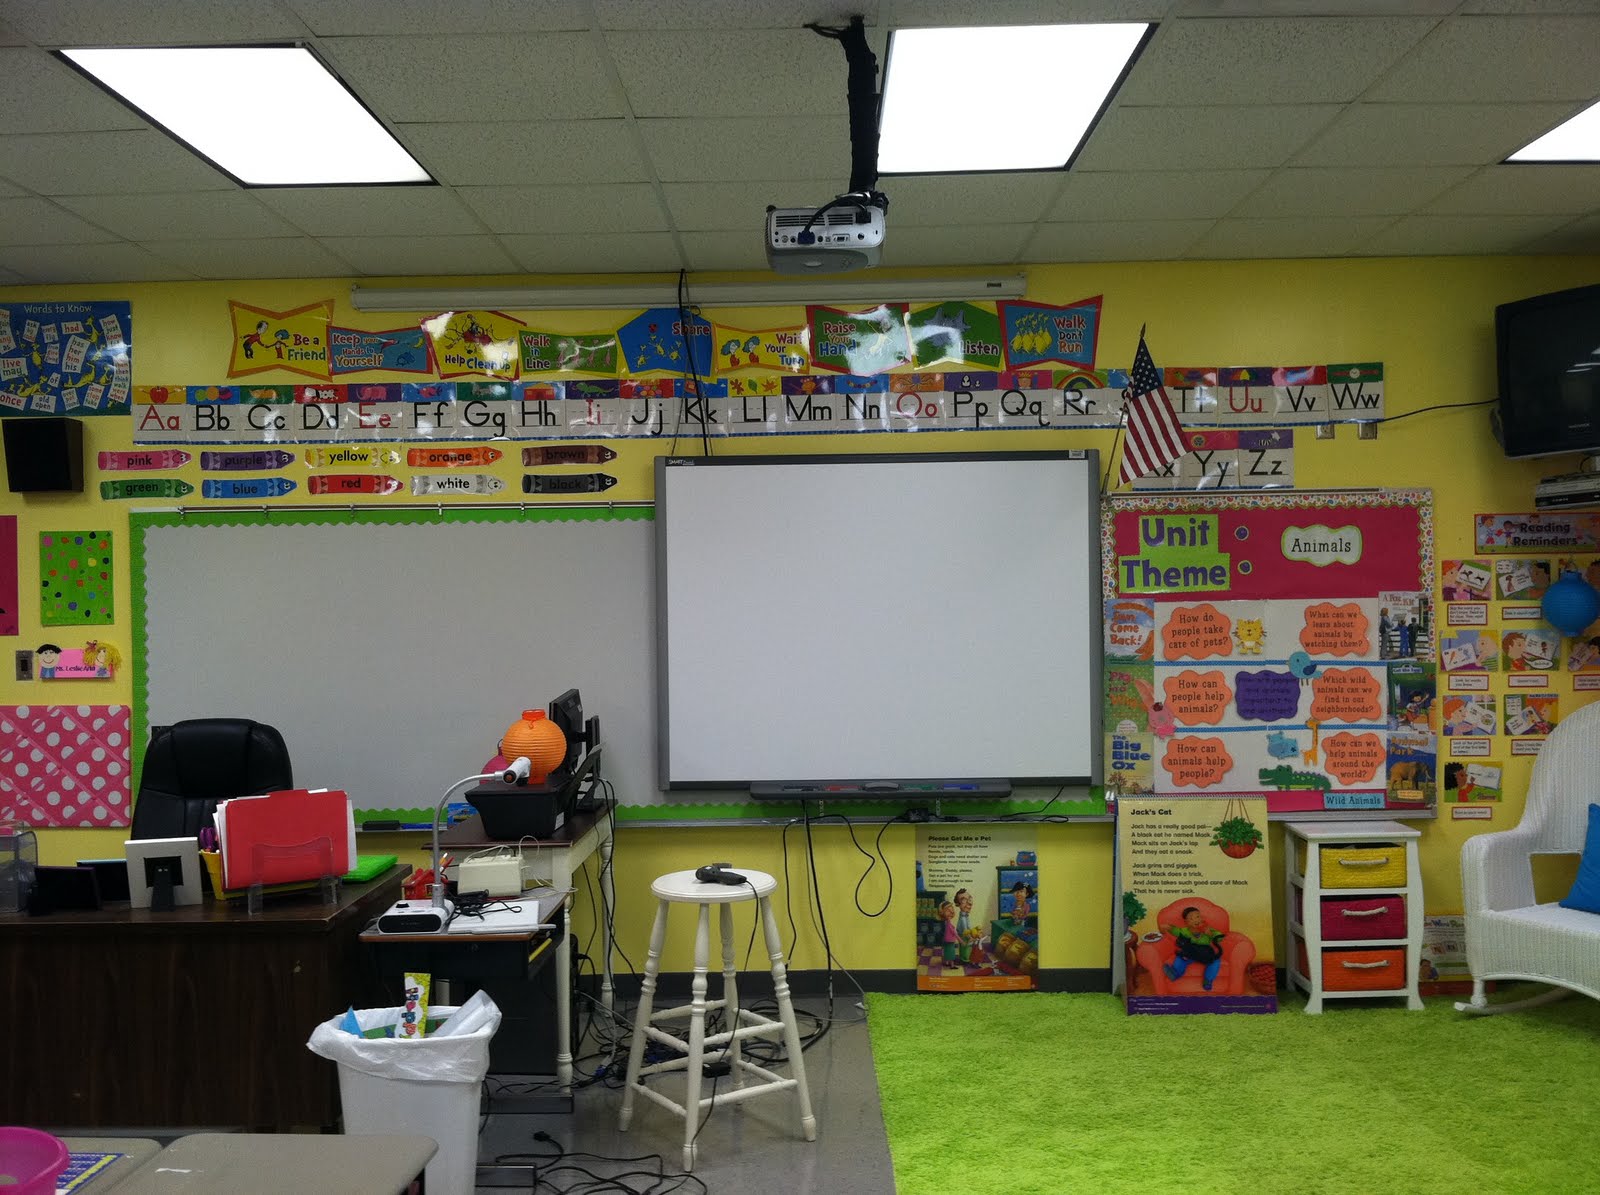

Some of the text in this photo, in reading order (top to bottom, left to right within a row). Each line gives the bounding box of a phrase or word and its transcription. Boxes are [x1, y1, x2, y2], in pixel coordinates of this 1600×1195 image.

[24, 304, 92, 313] Words to Know
[64, 324, 80, 332] had
[1053, 315, 1087, 330] Walk
[672, 322, 711, 336] Share
[824, 322, 857, 335] Raise
[293, 334, 320, 346] Be a
[333, 334, 378, 348] Keep your
[524, 334, 550, 347] Walk
[776, 333, 802, 345] Wait
[1059, 331, 1084, 342] Don't
[72, 338, 84, 348] has
[819, 340, 858, 356] Hand
[959, 340, 1000, 356] Listen
[1058, 342, 1084, 354] Run
[68, 346, 82, 356] her
[288, 348, 326, 360] Friend
[366, 346, 374, 355] to
[530, 347, 540, 356] in
[765, 344, 786, 354] Your
[2, 360, 21, 368] live
[66, 354, 80, 364] him
[336, 352, 384, 367] Yourself
[445, 354, 466, 367] Help
[467, 357, 498, 370] Clean
[526, 358, 550, 370] Line
[779, 354, 805, 366] Turn
[2, 368, 22, 376] may
[65, 362, 77, 371] his
[0, 394, 22, 406] once
[126, 448, 586, 468] pink purple yellow orange brown
[125, 478, 582, 496] green blue red white black
[1142, 516, 1210, 547] Unit
[1520, 523, 1571, 535] Reading
[1291, 538, 1352, 553] Animals
[1512, 536, 1578, 546] Reminders
[1122, 559, 1227, 588] Theme
[1180, 612, 1214, 624] How do
[1172, 624, 1224, 638] people take
[1344, 631, 1353, 639] by
[1168, 637, 1229, 649] care of pets?
[1305, 640, 1362, 648] watching them?
[1178, 680, 1198, 688] How
[1172, 692, 1225, 702] people help
[1178, 704, 1219, 713] animals?
[1112, 741, 1142, 752] Big
[1178, 744, 1216, 753] How can
[1390, 747, 1414, 756] Park
[1112, 750, 1152, 760] Blue
[1330, 750, 1346, 758] help
[1112, 761, 1136, 770] Ox
[1168, 756, 1226, 767] animals help
[1180, 769, 1215, 779] people?
[1326, 796, 1380, 805] Wild Animals
